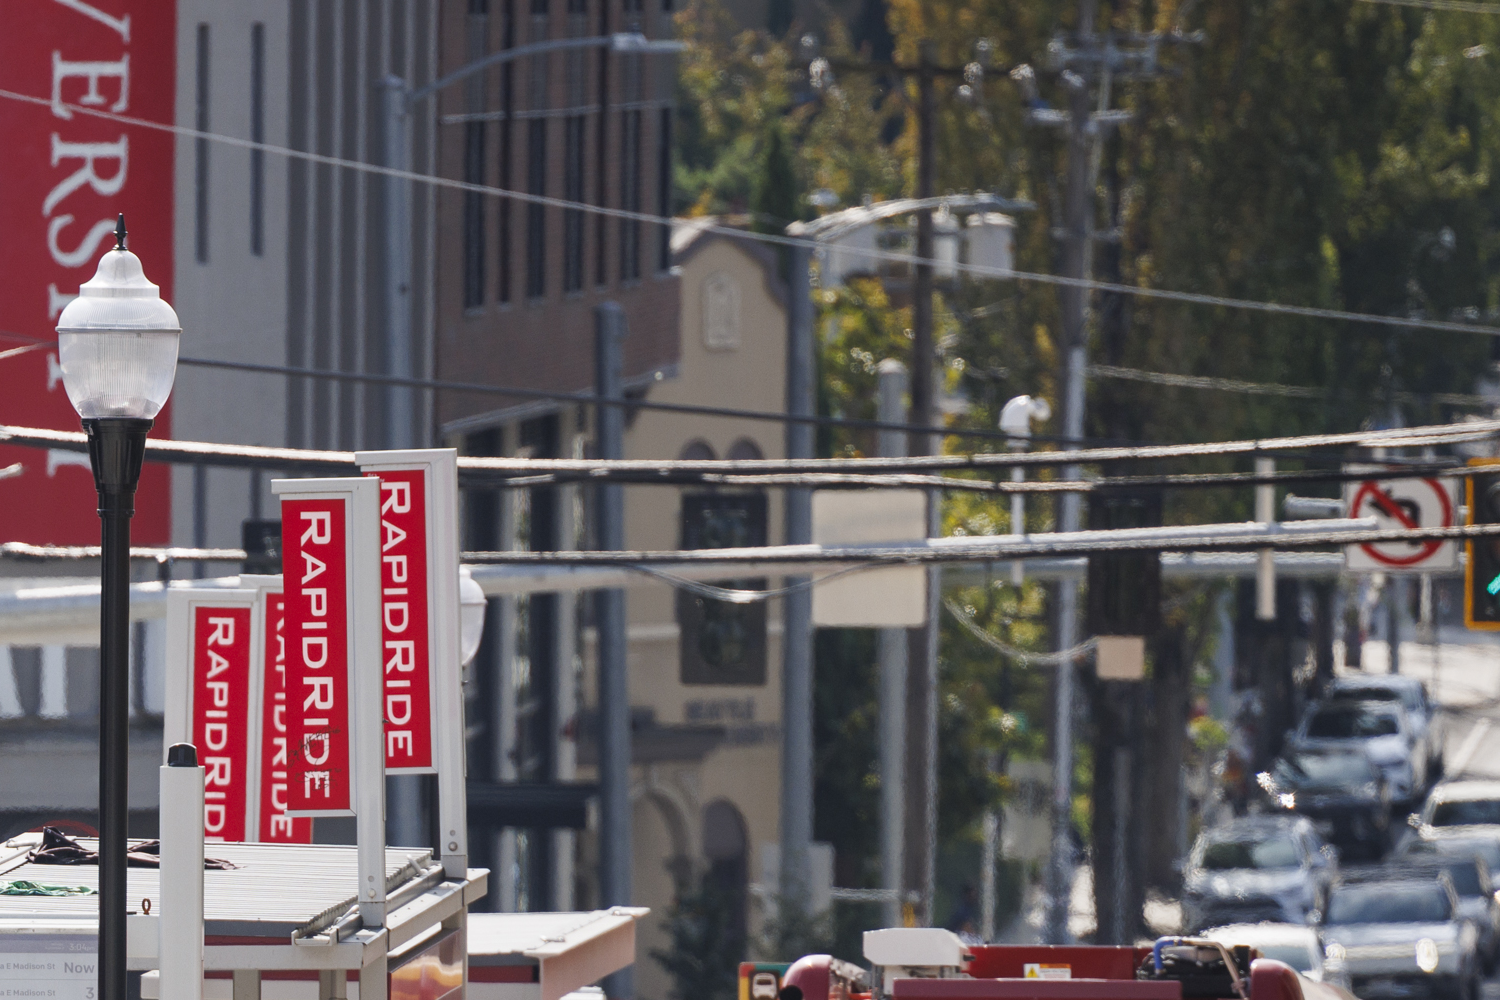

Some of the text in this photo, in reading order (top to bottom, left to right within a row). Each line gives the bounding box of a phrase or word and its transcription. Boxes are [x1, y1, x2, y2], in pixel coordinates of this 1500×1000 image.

[204, 617, 235, 842] RAPIDRID
[300, 510, 333, 798] RAPIDRIDE
[381, 481, 415, 757] RAPIDRIDE
[13, 989, 45, 997] Madison
[47, 989, 56, 997] St
[85, 987, 95, 1000] 3
[64, 962, 95, 973] Now
